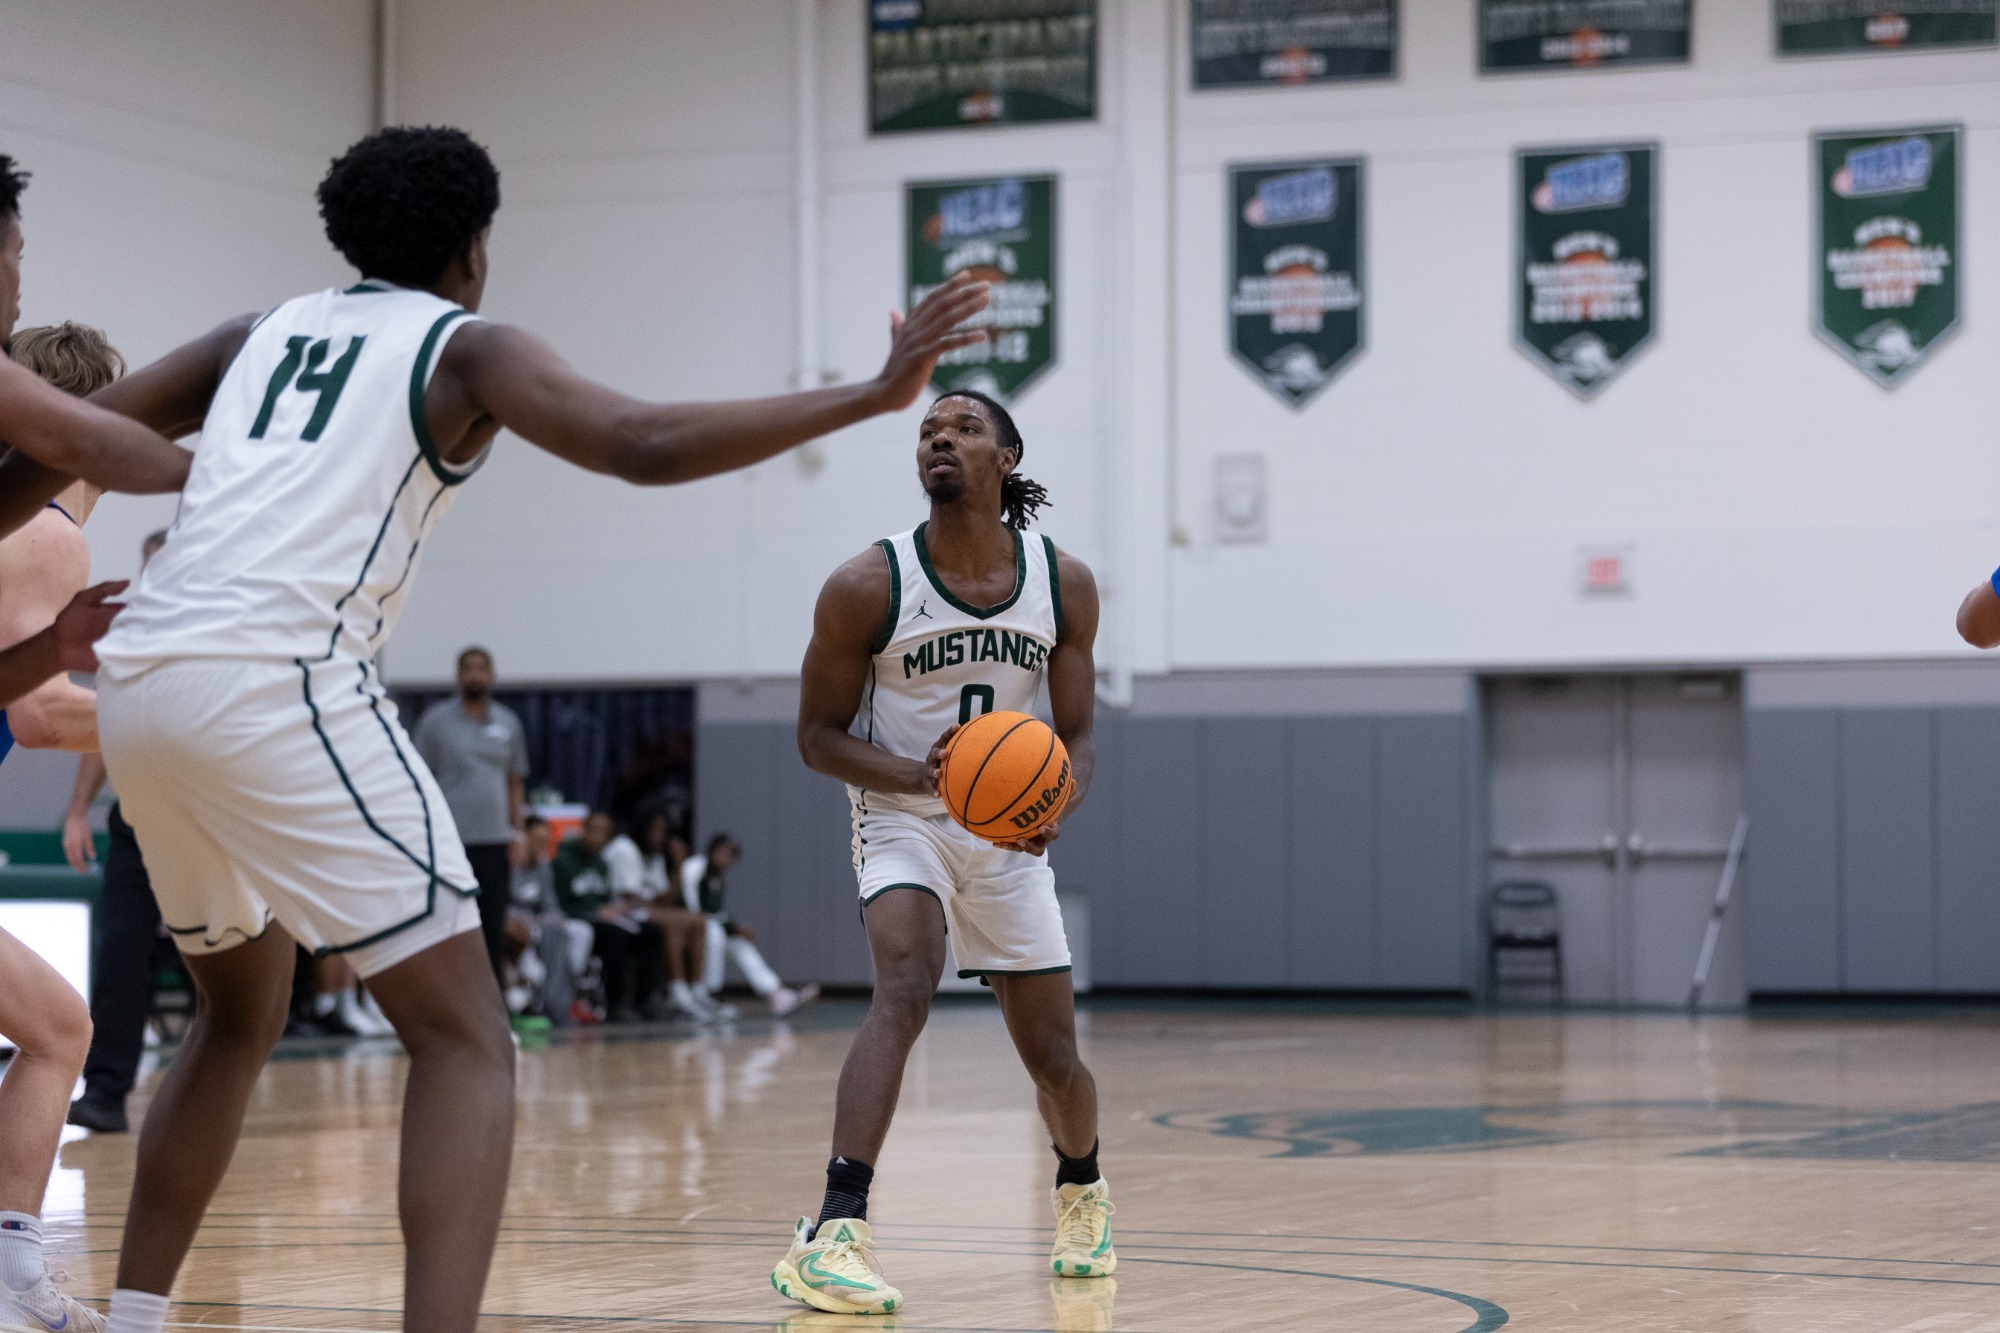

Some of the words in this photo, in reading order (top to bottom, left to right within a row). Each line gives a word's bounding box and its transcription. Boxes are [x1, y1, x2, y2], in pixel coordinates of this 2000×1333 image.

[248, 335, 368, 443] 14
[903, 628, 1048, 679] MUSTANGS
[958, 683, 995, 726] 0
[1009, 758, 1070, 829] Wilson
